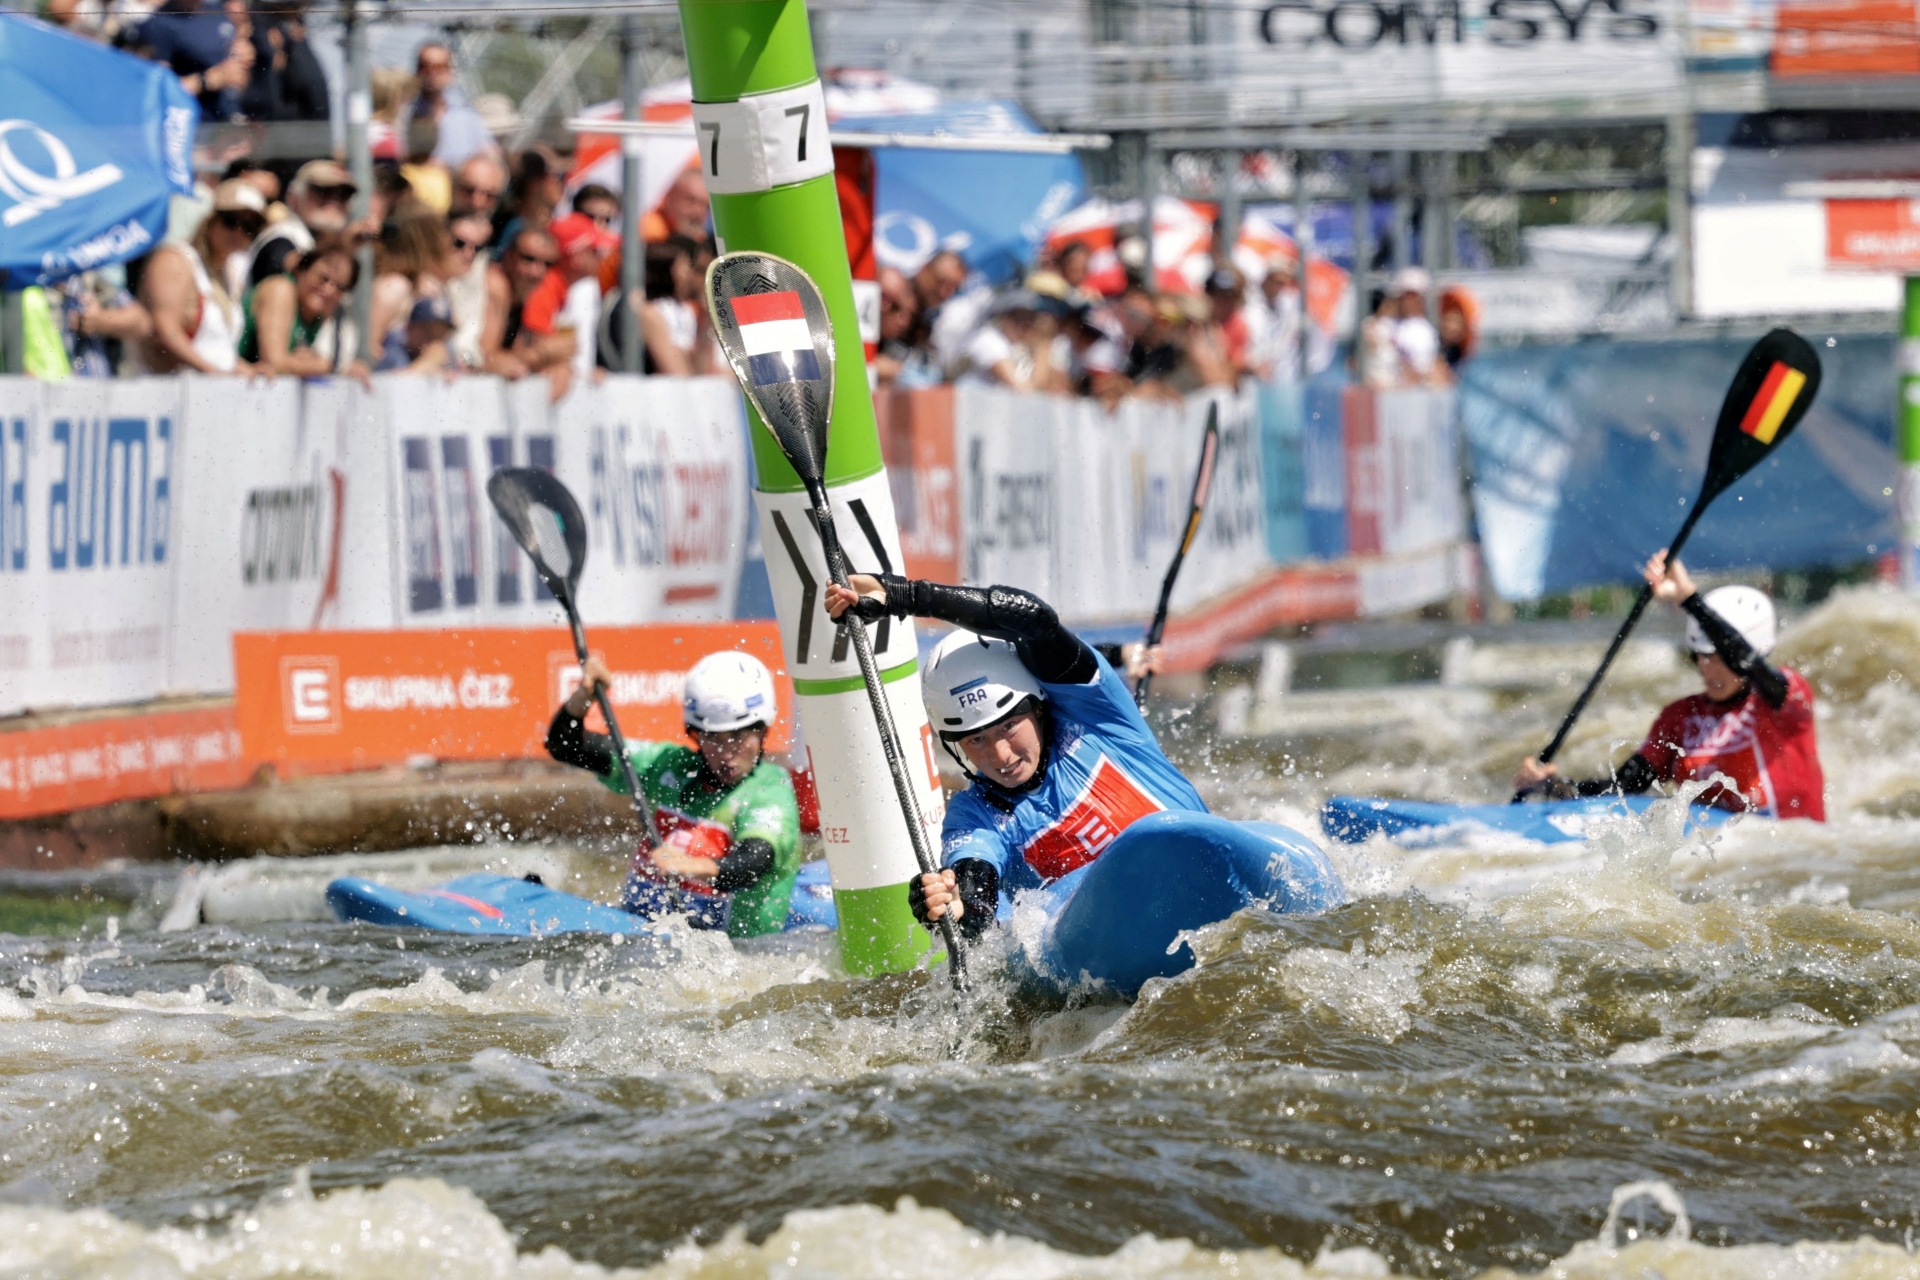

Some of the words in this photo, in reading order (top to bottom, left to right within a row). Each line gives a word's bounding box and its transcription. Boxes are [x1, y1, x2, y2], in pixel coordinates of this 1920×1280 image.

[700, 121, 720, 176] 7
[785, 104, 810, 162] 7
[49, 417, 171, 571] auma
[958, 688, 987, 708] FRA
